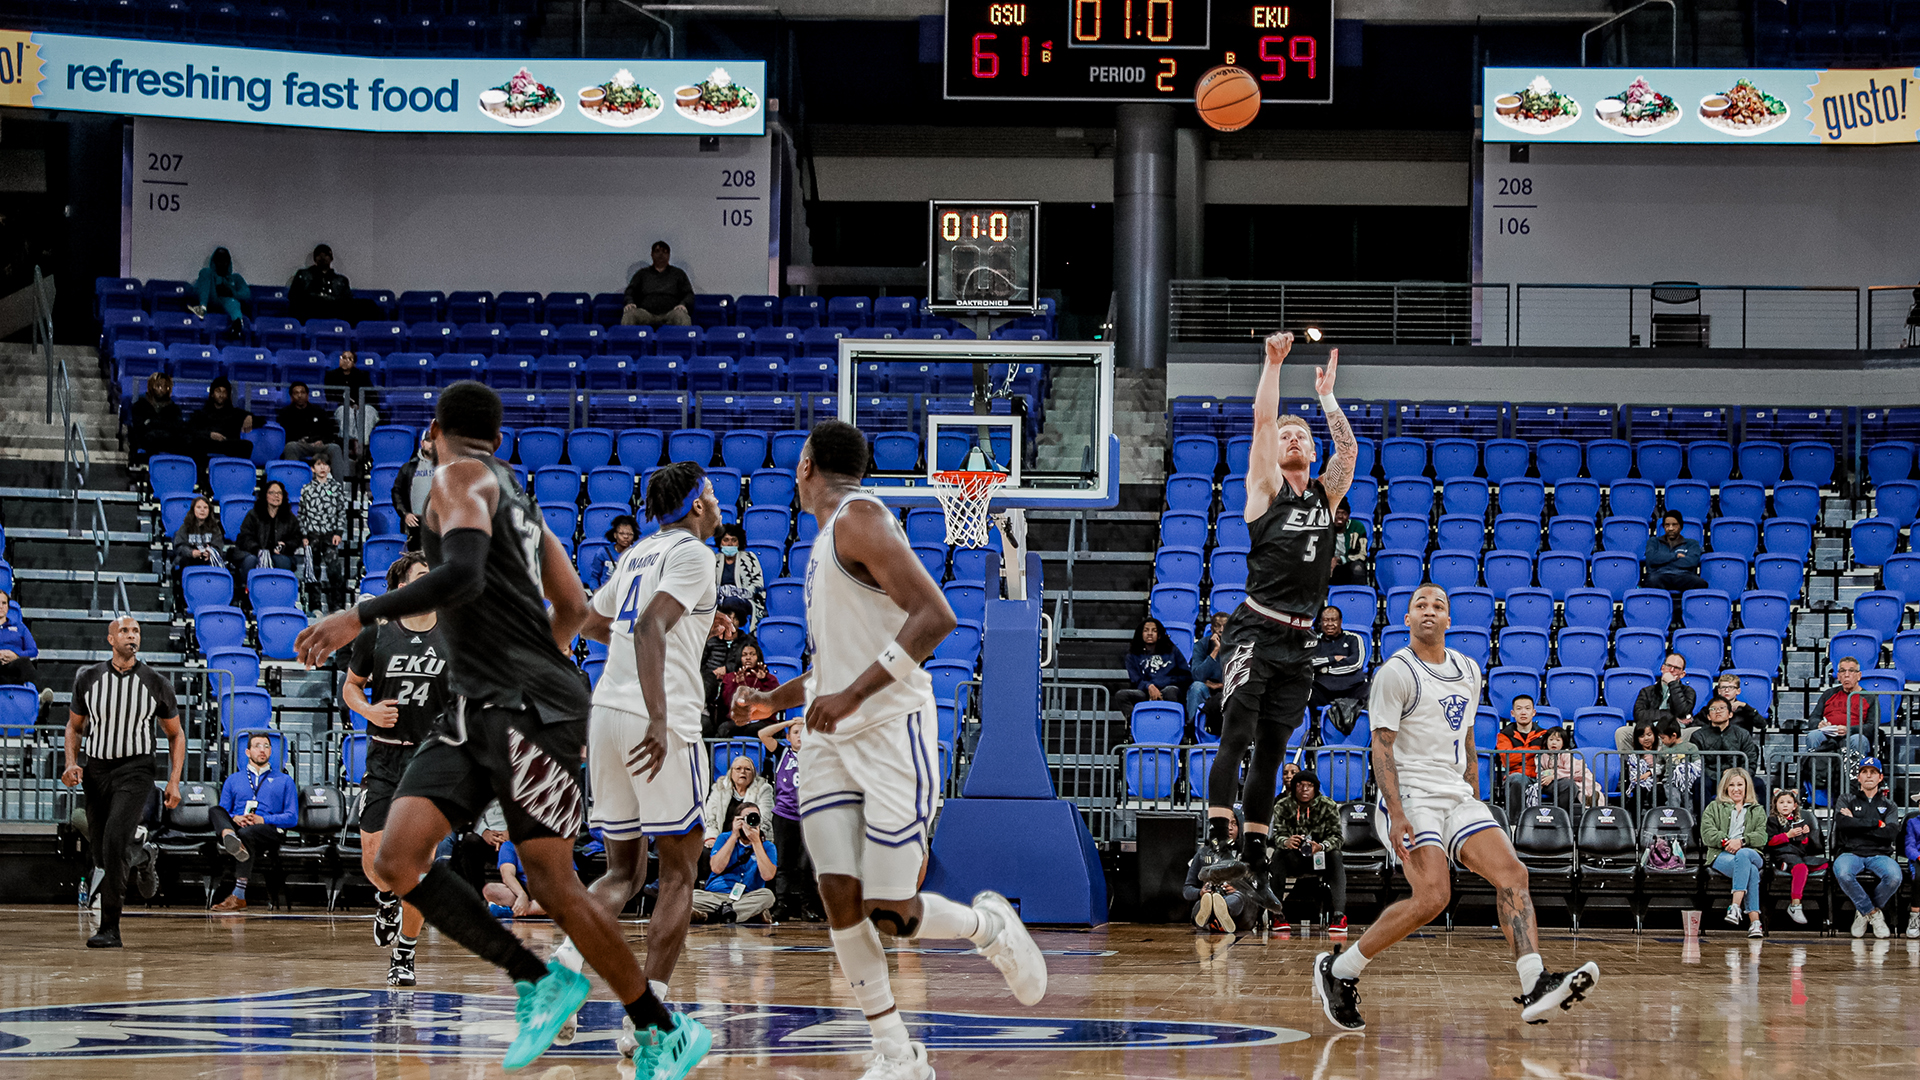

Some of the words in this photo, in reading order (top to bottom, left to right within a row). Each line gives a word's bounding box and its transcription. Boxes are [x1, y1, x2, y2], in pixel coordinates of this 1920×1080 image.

[990, 4, 1026, 25] GSU
[1253, 6, 1290, 28] EKU
[972, 32, 1030, 78] 61
[1041, 50, 1051, 63] B
[1225, 51, 1236, 65] B
[1259, 35, 1316, 81] 59
[67, 58, 270, 113] refreshing
[283, 72, 359, 110] fast
[369, 78, 459, 112] food
[1089, 66, 1146, 83] PERIOD
[1156, 58, 1177, 91] 2
[1822, 78, 1907, 140] gusto!
[148, 153, 183, 171] 207
[722, 170, 756, 187] 208
[1498, 178, 1533, 195] 208
[149, 193, 180, 212] 105
[723, 209, 753, 226] 105
[941, 211, 1008, 242] 01.0
[1499, 217, 1531, 235] 106
[1303, 535, 1319, 562] 5
[616, 574, 643, 634] 4
[386, 655, 446, 675] EKU
[397, 680, 431, 707] 24
[1453, 739, 1460, 765] 1
